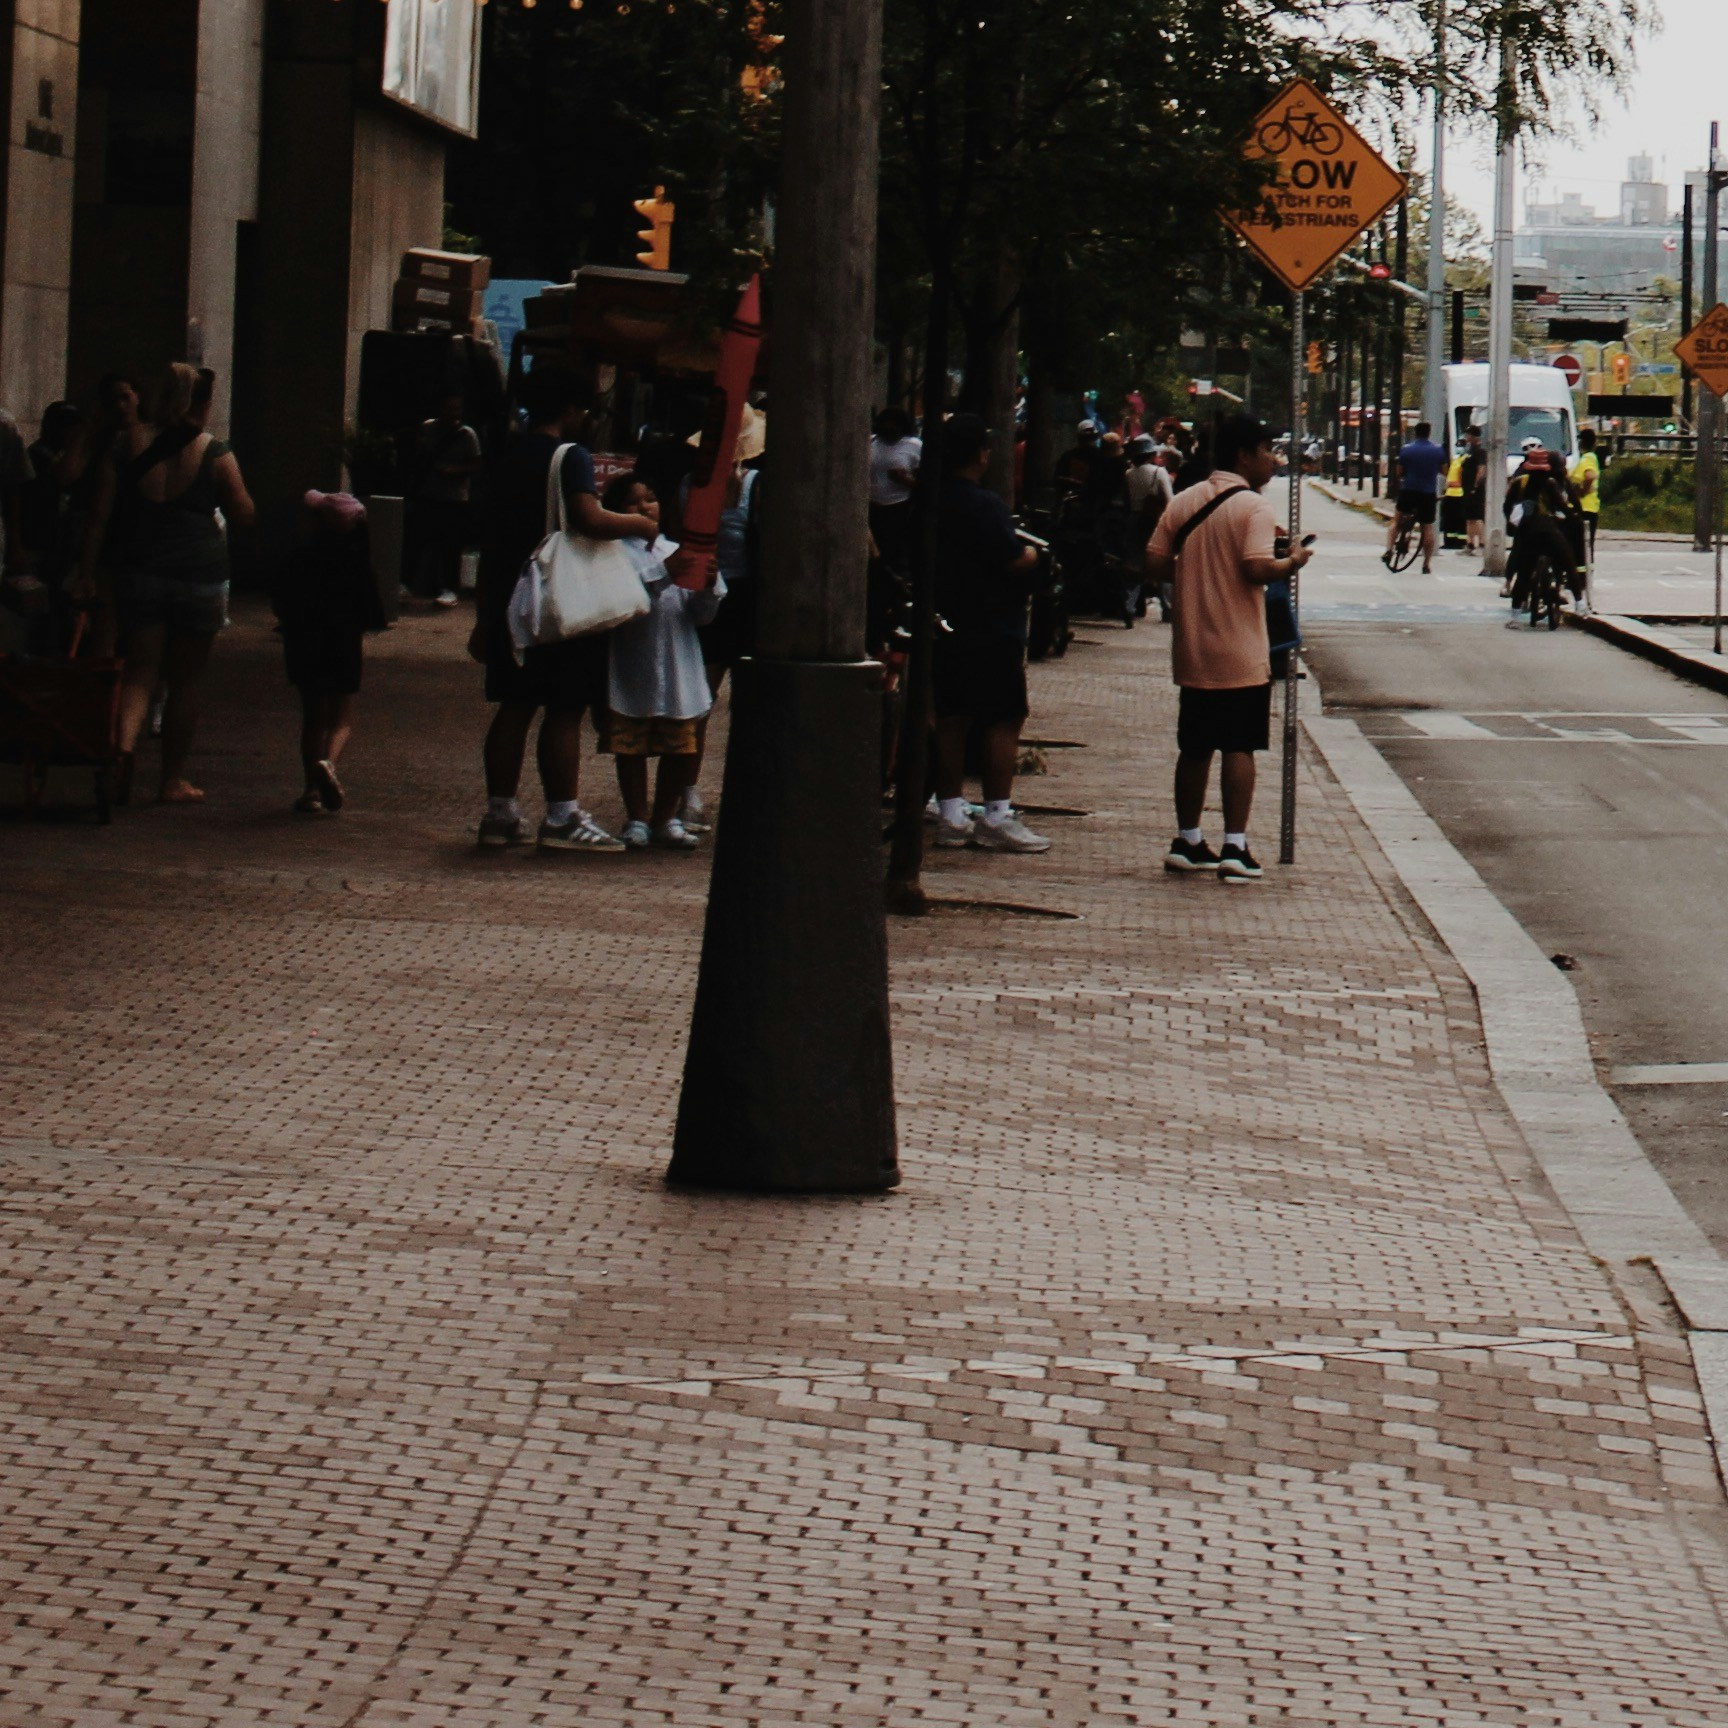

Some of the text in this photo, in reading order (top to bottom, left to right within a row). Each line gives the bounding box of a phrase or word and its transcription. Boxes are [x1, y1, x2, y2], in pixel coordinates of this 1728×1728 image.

[1257, 159, 1358, 189] LOW
[1258, 194, 1352, 209] ATCH FOR
